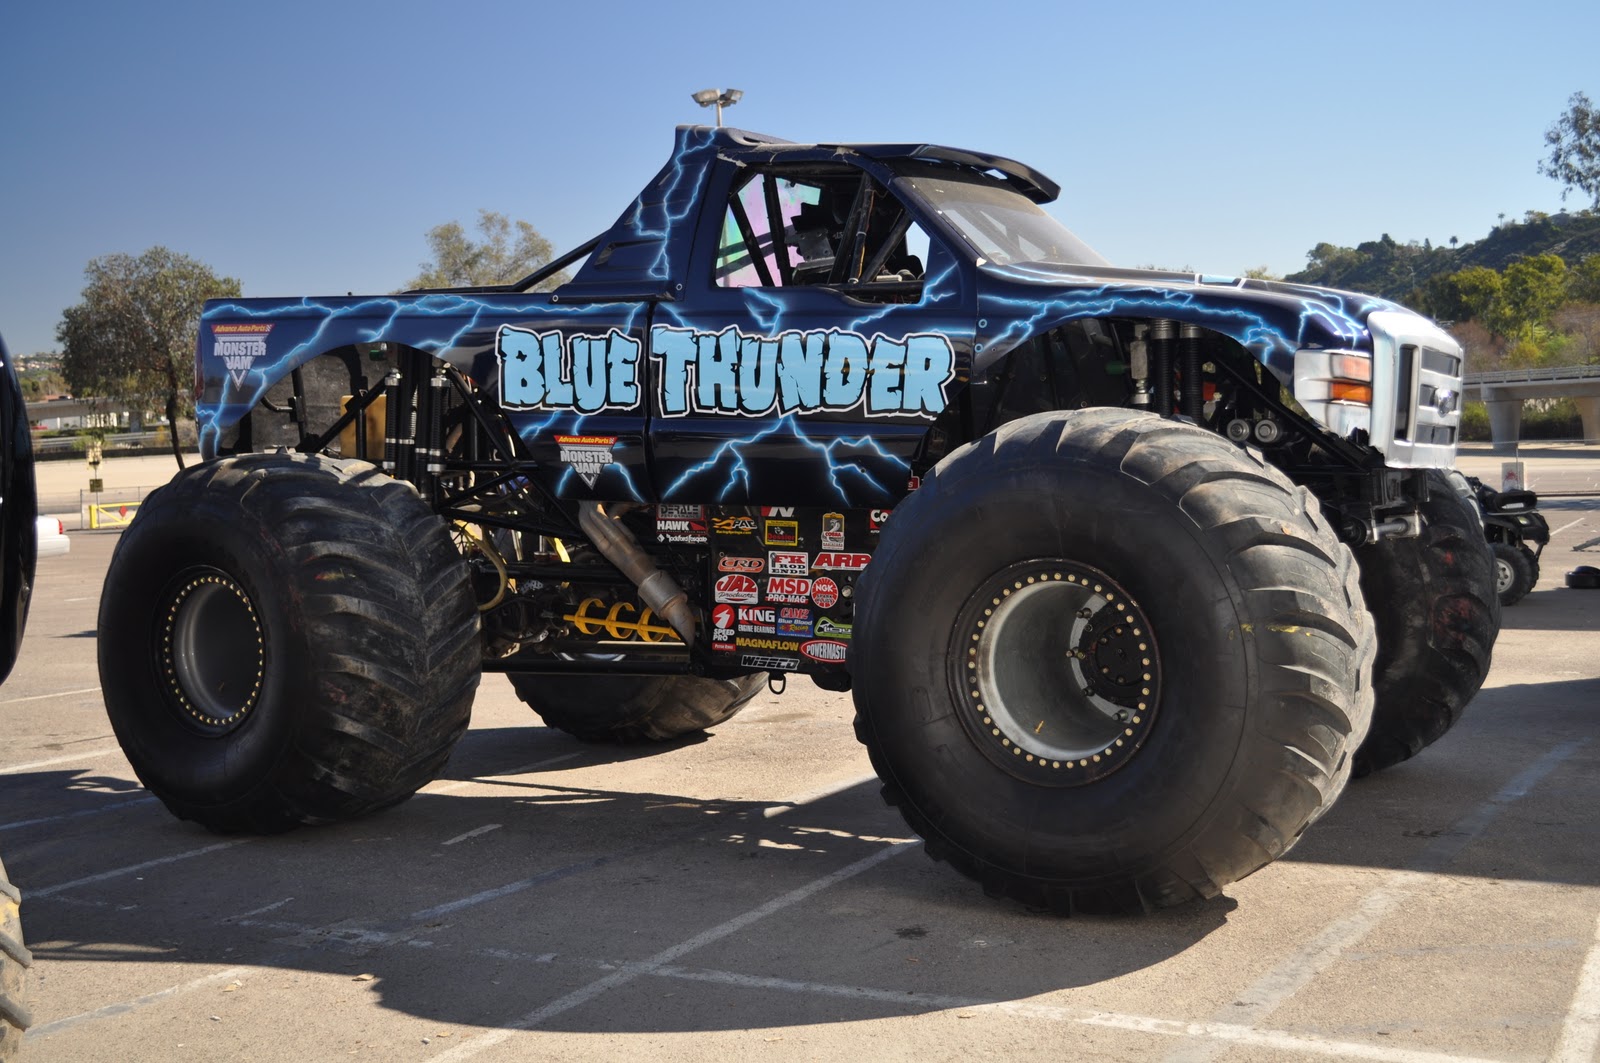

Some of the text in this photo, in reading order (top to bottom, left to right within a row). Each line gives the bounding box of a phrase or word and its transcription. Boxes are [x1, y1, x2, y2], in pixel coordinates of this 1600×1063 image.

[213, 341, 267, 356] MONSTER
[225, 356, 252, 370] JAM
[497, 325, 953, 416] BLUE THUNDER
[560, 451, 613, 463] MONSTER
[573, 462, 601, 474] JAM
[657, 520, 690, 531] HAWK
[775, 556, 806, 564] FK
[814, 553, 872, 568] ARP
[717, 575, 757, 592] JAZ
[769, 578, 809, 595] MSD
[815, 584, 834, 592] NGK
[738, 608, 776, 623] KING
[714, 628, 735, 636] SPEED
[738, 624, 753, 632] ENGINE
[736, 637, 800, 652] MAGNAFLOW
